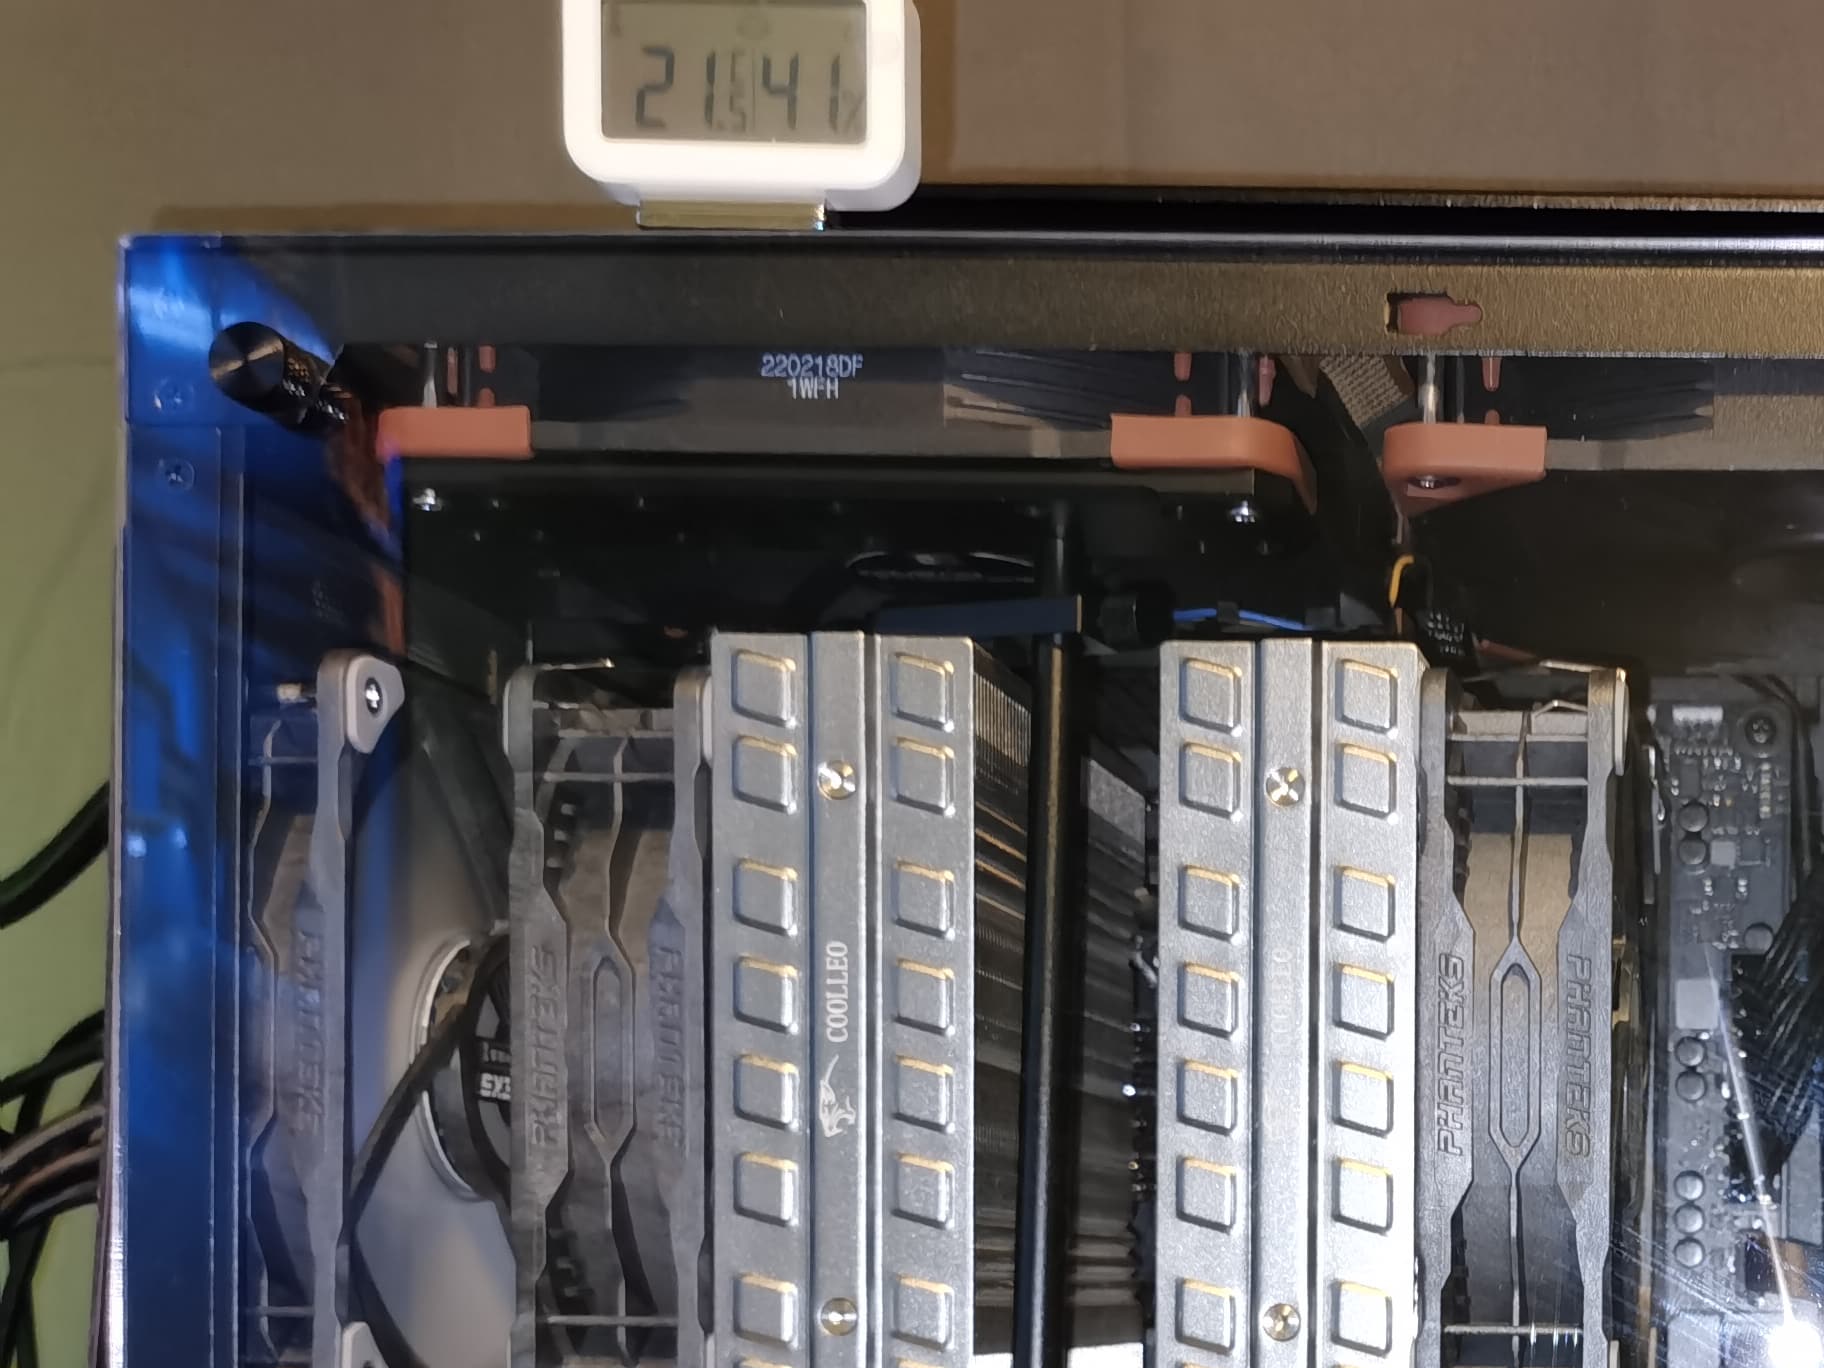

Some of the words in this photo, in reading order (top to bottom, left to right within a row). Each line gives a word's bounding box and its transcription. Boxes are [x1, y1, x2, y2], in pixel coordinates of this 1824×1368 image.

[761, 352, 864, 378] 220218DF
[787, 376, 839, 400] 1WFH
[826, 940, 849, 1043] COOLLEO
[1436, 952, 1465, 1157] PHANTEKS
[1565, 953, 1592, 1158] PHANTEKS
